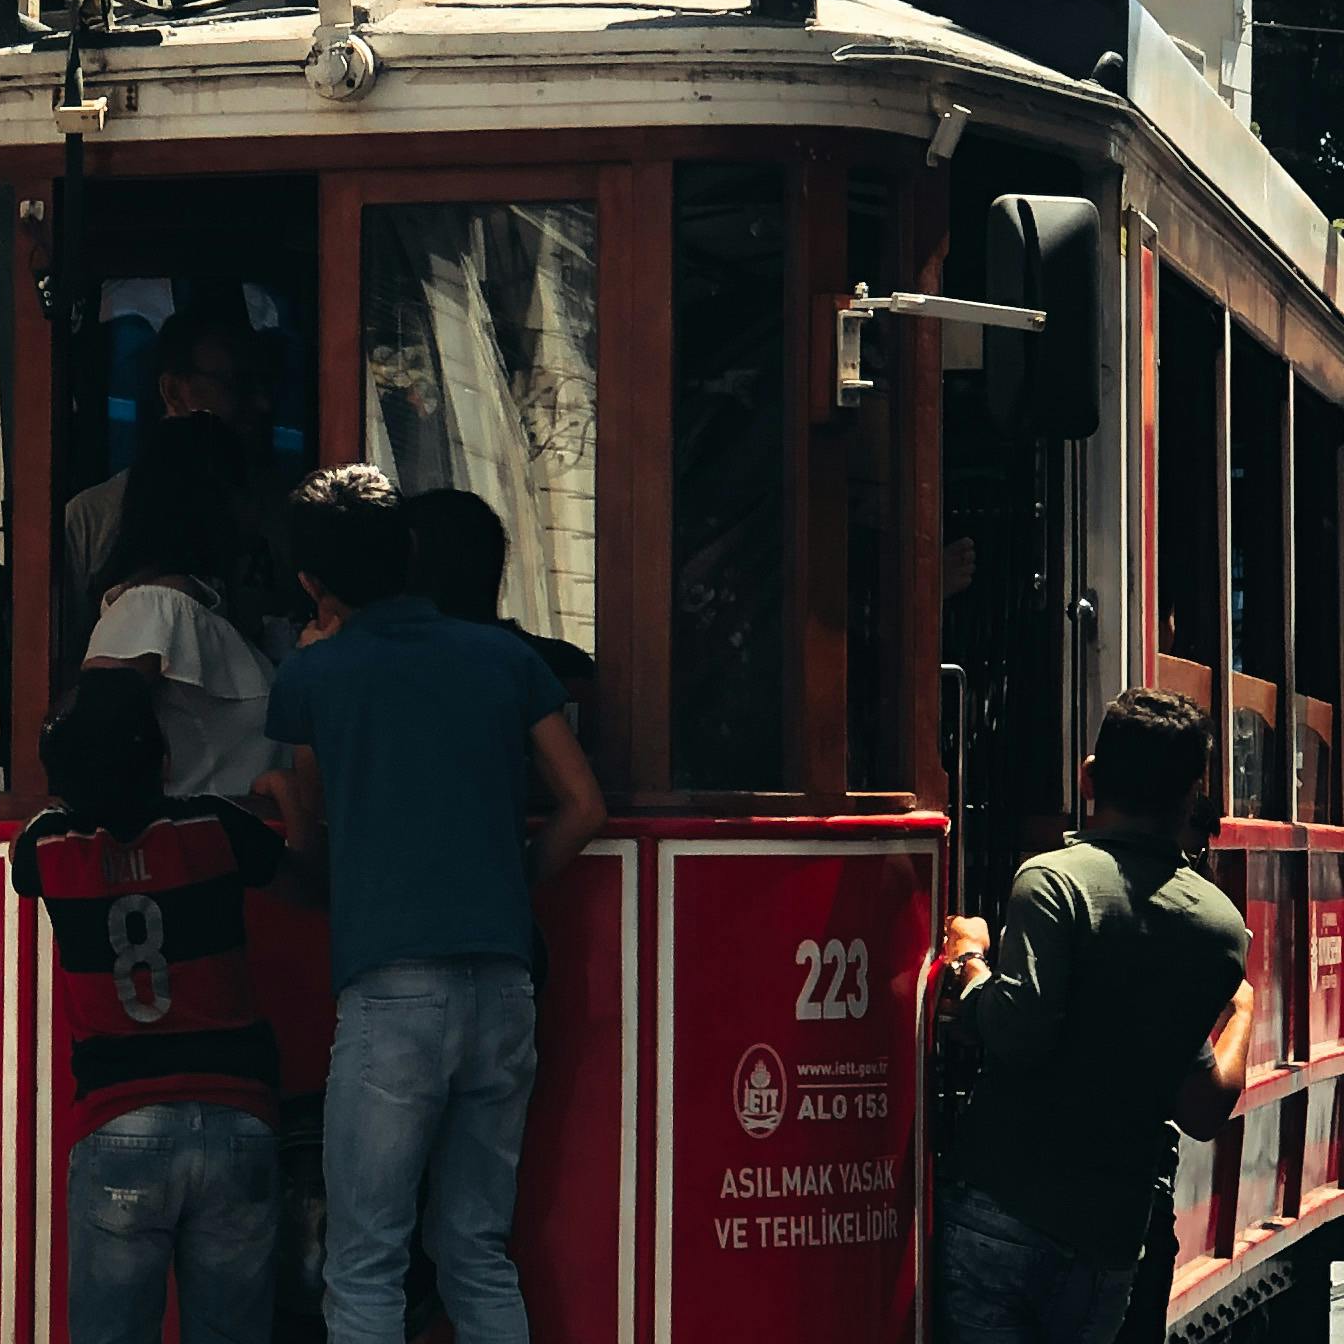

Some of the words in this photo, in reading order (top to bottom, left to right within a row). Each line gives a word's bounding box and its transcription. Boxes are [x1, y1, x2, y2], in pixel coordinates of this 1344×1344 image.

[107, 894, 172, 1024] 8
[794, 938, 869, 1021] 223
[797, 1060, 888, 1077] www.iett.gov.tr
[796, 1094, 848, 1120] ALO
[853, 1092, 888, 1119] 153
[719, 1163, 834, 1199] ASILMAK
[838, 1159, 895, 1193] YASAK
[713, 1217, 748, 1250] VE
[755, 1202, 899, 1249] TEHLİKELİDİR
